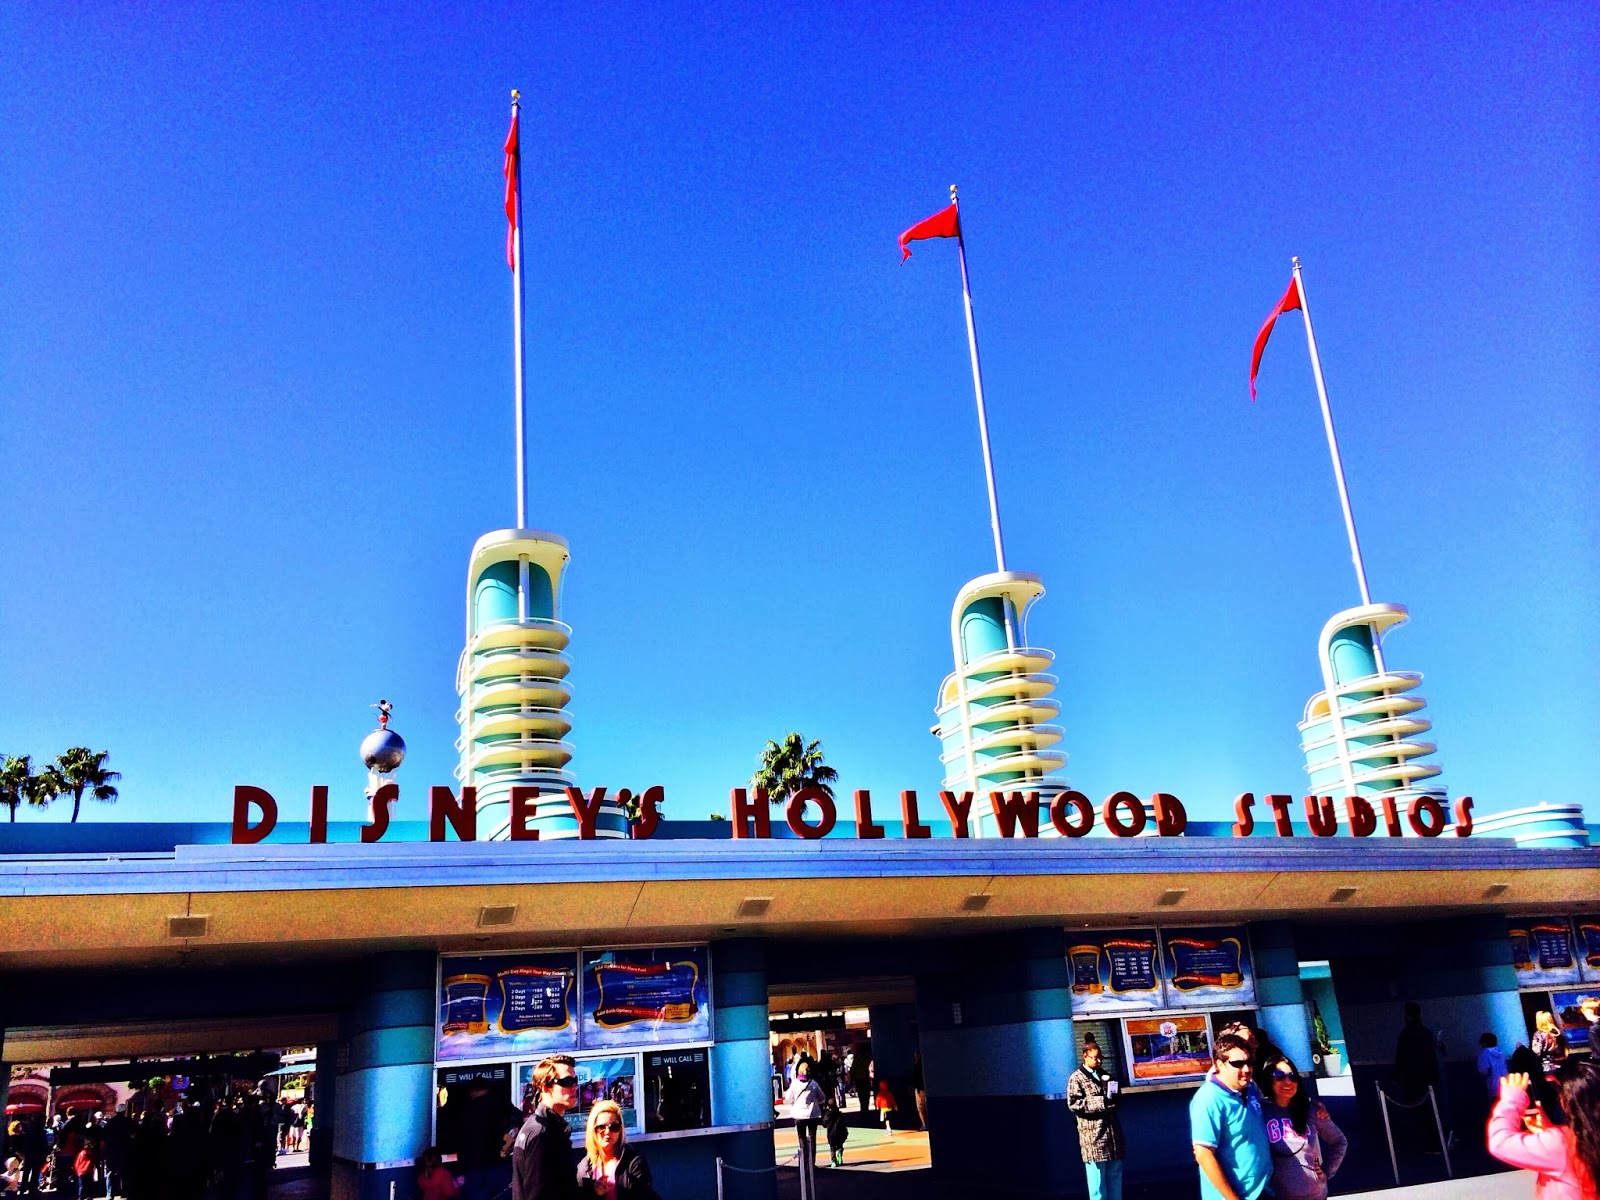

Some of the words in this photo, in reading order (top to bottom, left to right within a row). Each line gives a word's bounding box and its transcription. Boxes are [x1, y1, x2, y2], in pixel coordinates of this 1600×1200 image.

[231, 785, 665, 844] DISNEY'S
[731, 786, 1187, 839] HOLLYWOOD
[1232, 792, 1474, 838] STUDIOS
